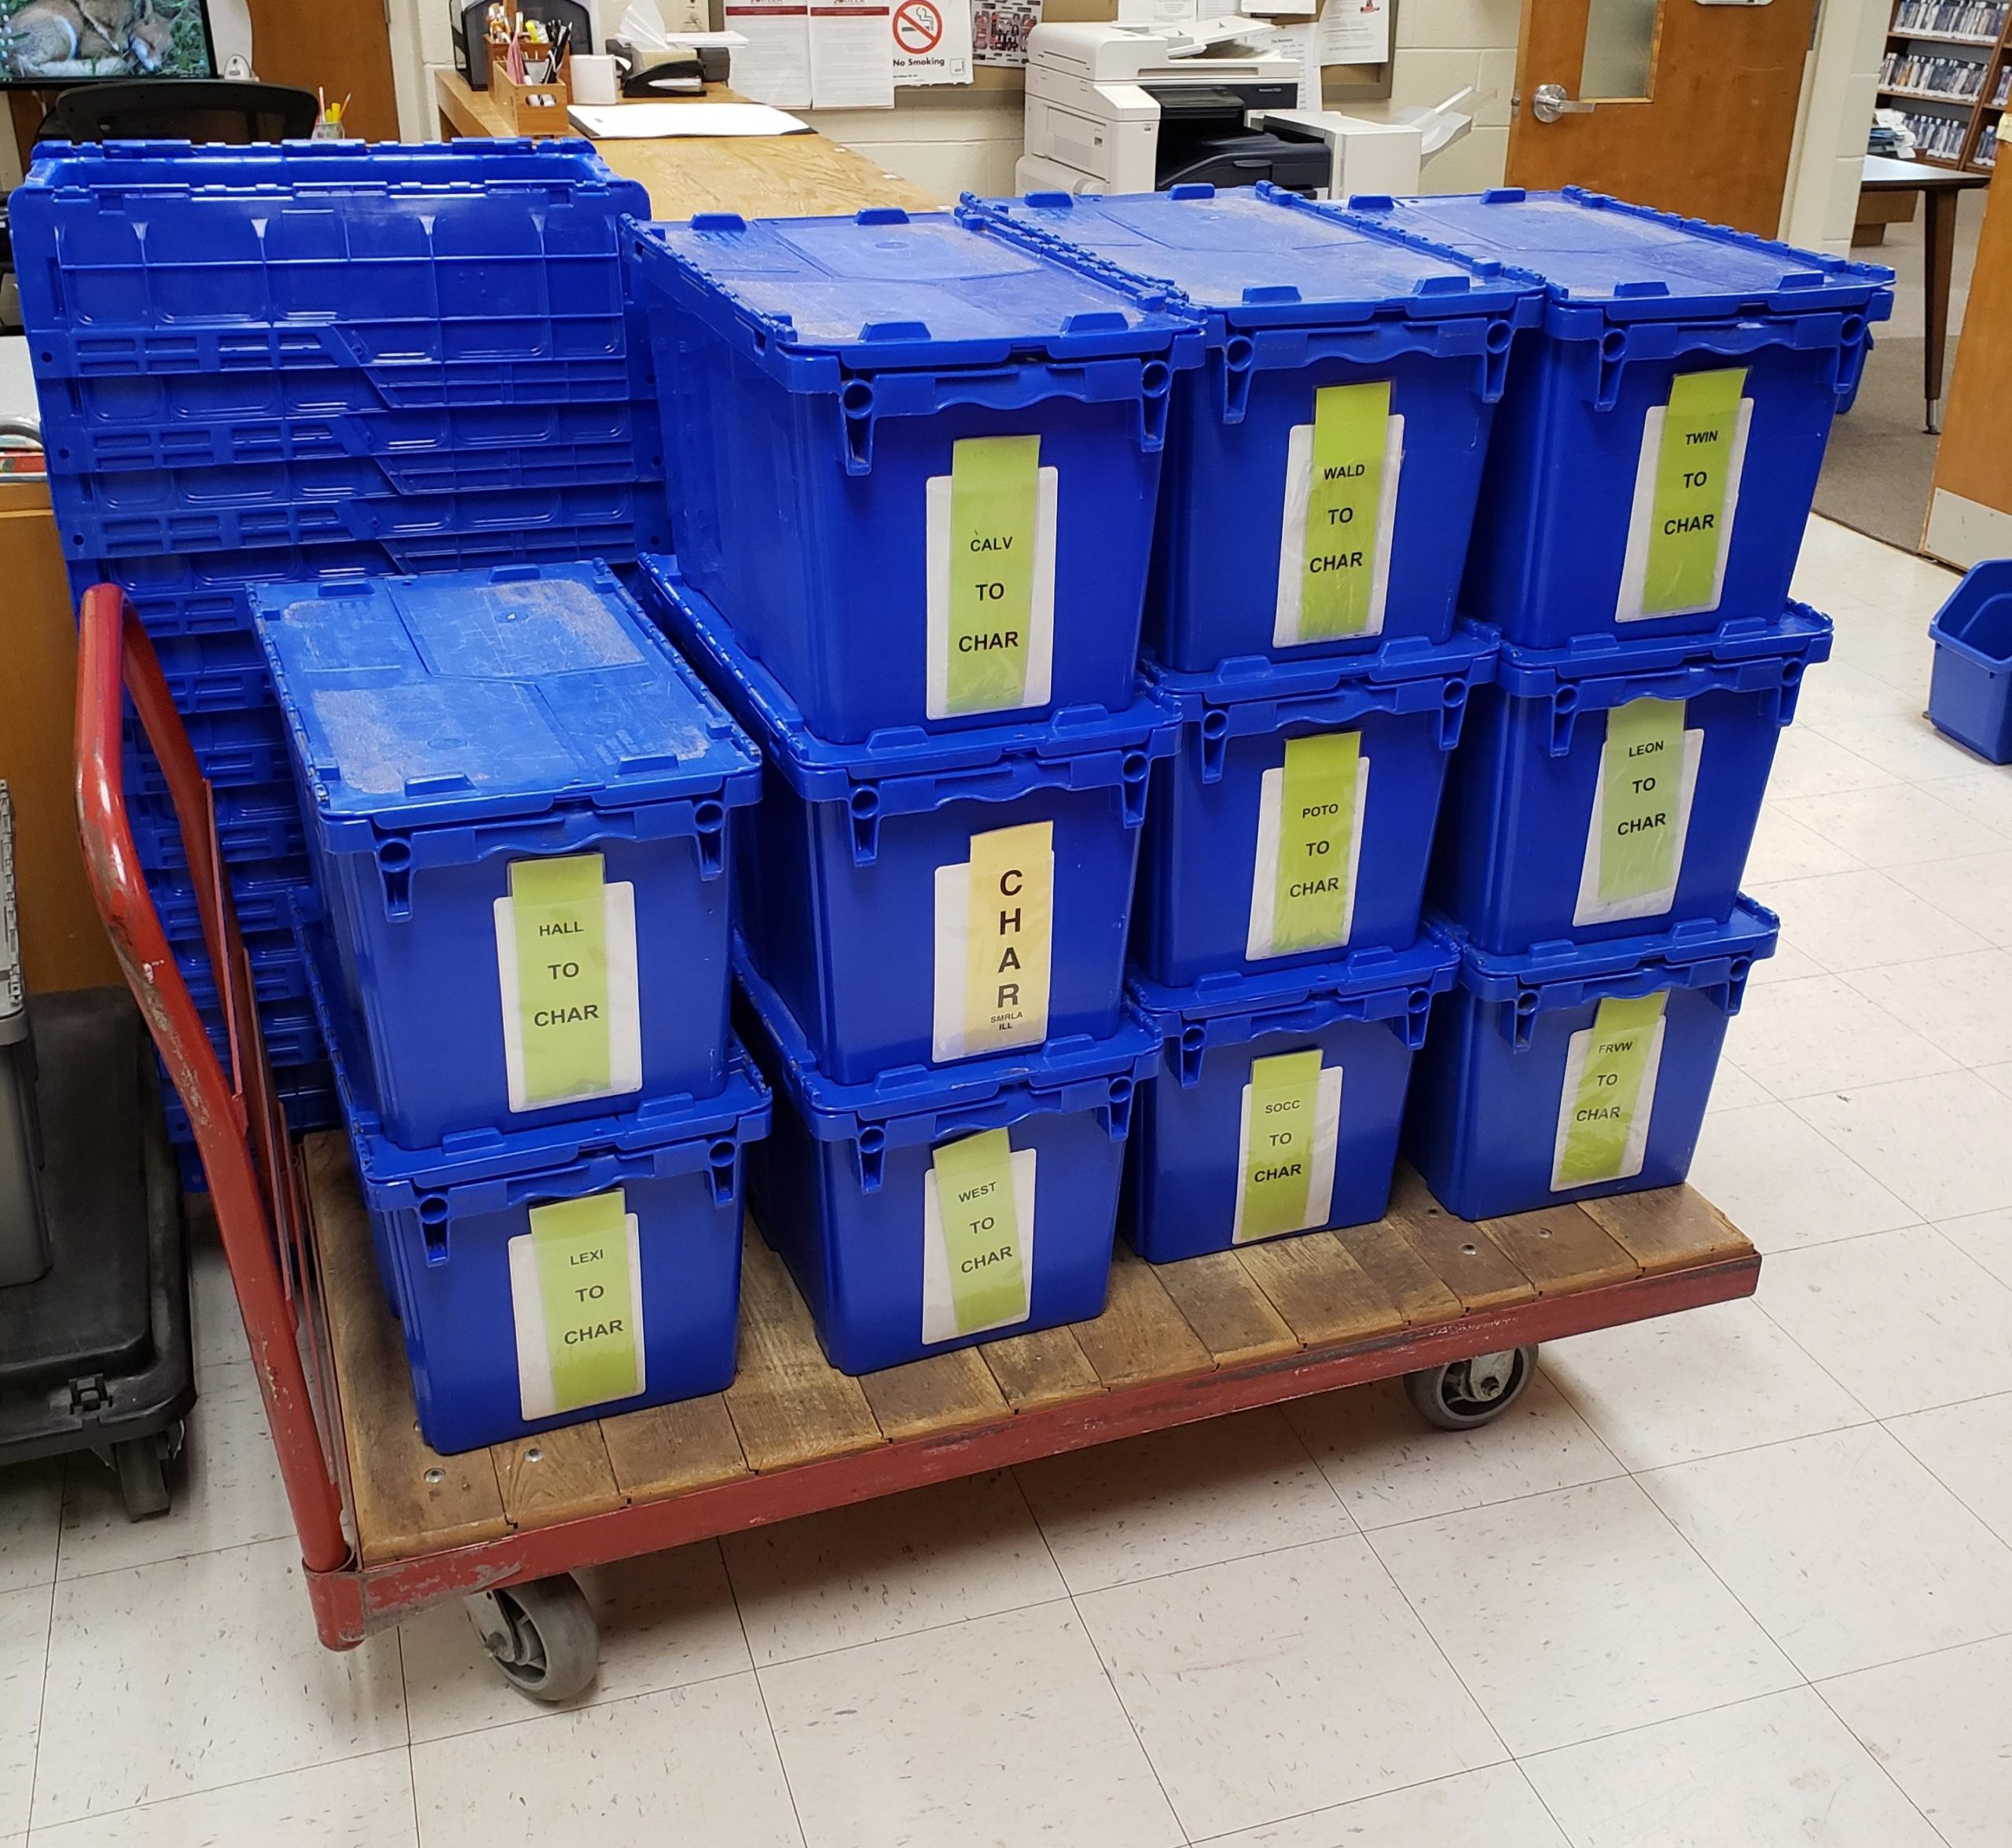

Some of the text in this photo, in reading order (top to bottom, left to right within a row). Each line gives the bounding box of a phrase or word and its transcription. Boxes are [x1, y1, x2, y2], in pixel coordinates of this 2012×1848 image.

[908, 57, 945, 66] Smoking
[1686, 430, 1719, 446] TWIN
[1324, 465, 1365, 480] WALD
[1683, 471, 1708, 489] TO
[1327, 507, 1353, 525] TO
[1664, 513, 1715, 535] CHAR
[971, 536, 1013, 553] CALV
[1309, 551, 1363, 574] CHAR
[975, 582, 1004, 601] TO
[959, 630, 1019, 652] CHAR
[1628, 740, 1664, 758] LEON
[1632, 777, 1656, 794] TO
[1302, 803, 1339, 819] POTO
[1617, 812, 1666, 836] CHAR
[1305, 840, 1330, 857] TO
[1290, 876, 1339, 898] CHAR
[539, 920, 584, 937] HALL
[547, 962, 580, 980] TO
[534, 1004, 600, 1028] CHAR
[990, 1012, 1023, 1023] SMRLA
[999, 1023, 1013, 1031] ILL
[1599, 1041, 1633, 1054] FRVW
[1596, 1072, 1619, 1088] TO
[1265, 1100, 1300, 1114] SOCC
[1576, 1105, 1621, 1122] CHAR
[1269, 1132, 1292, 1147] TO
[1254, 1163, 1302, 1183] CHAR
[958, 1181, 997, 1203] WEST
[970, 1216, 995, 1235] TO
[570, 1248, 604, 1266] LEXI
[960, 1246, 1013, 1273] CHAR
[575, 1284, 605, 1302] TO
[564, 1319, 624, 1346] CHAR
